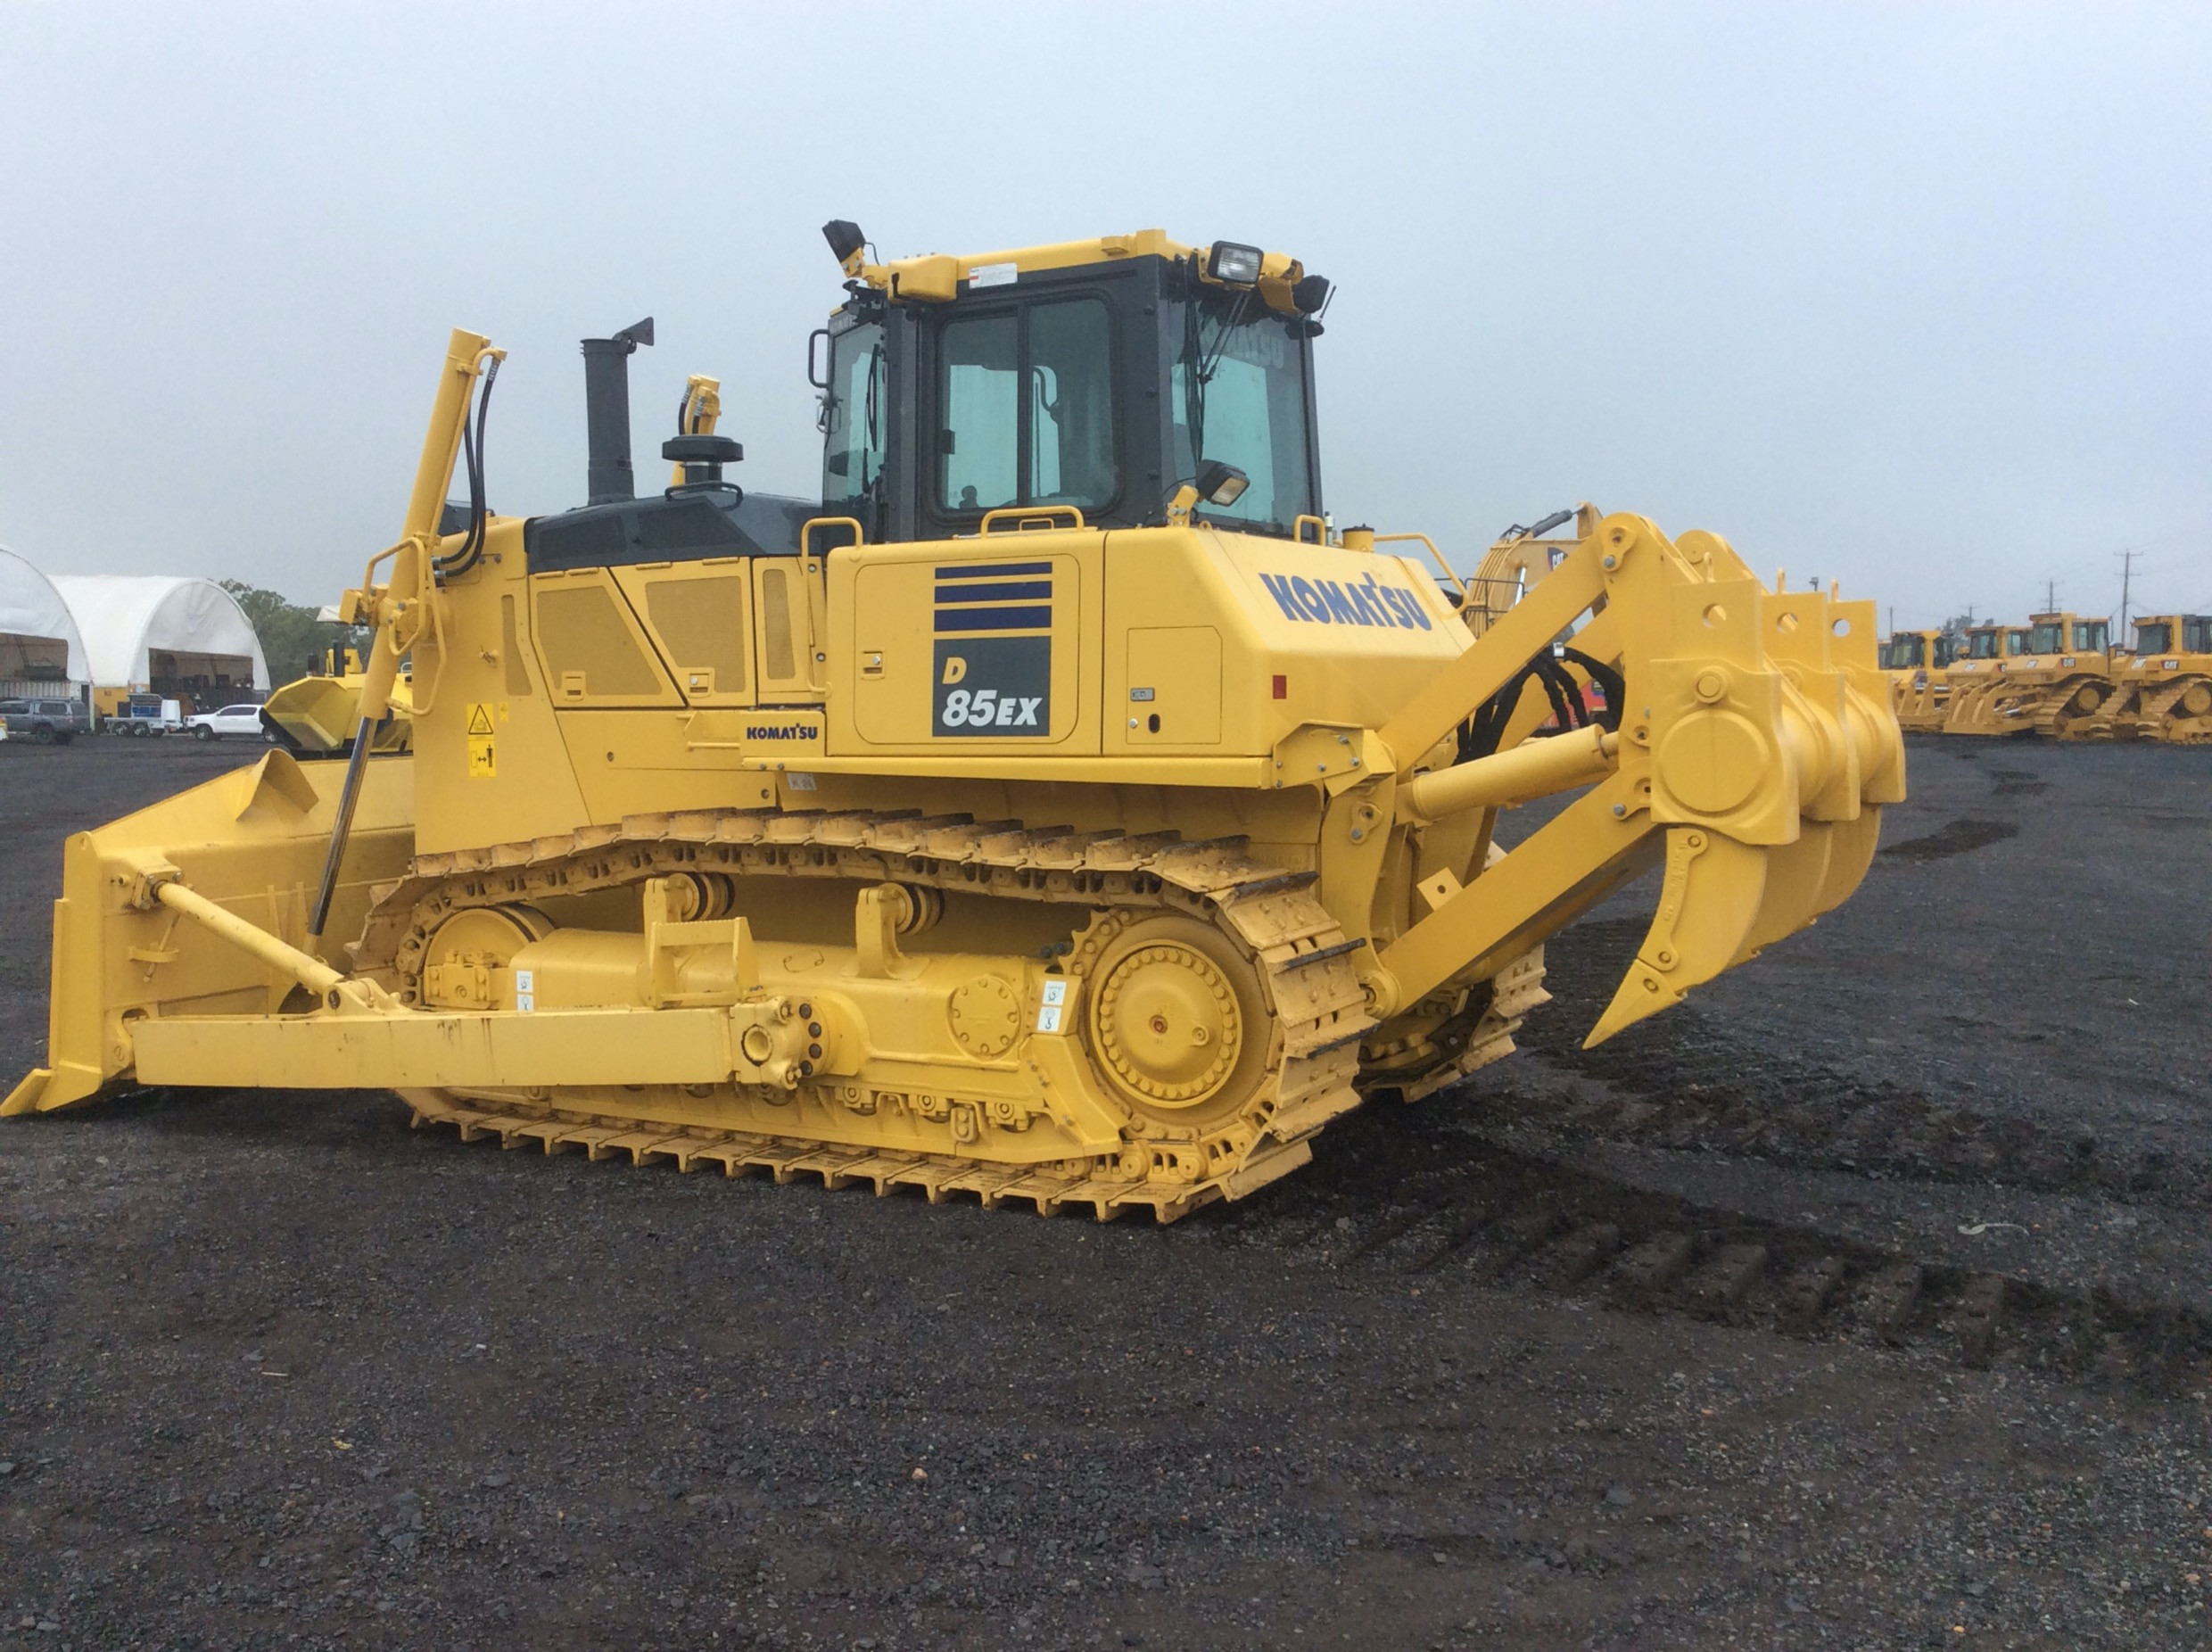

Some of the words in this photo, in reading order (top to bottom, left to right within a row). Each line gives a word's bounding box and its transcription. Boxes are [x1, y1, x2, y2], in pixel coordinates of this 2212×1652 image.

[1258, 572, 1432, 632] KOMATSU
[942, 657, 967, 685] D
[2163, 660, 2178, 671] CAT
[942, 689, 1044, 727] 85EX
[747, 723, 818, 739] KOMATSU
